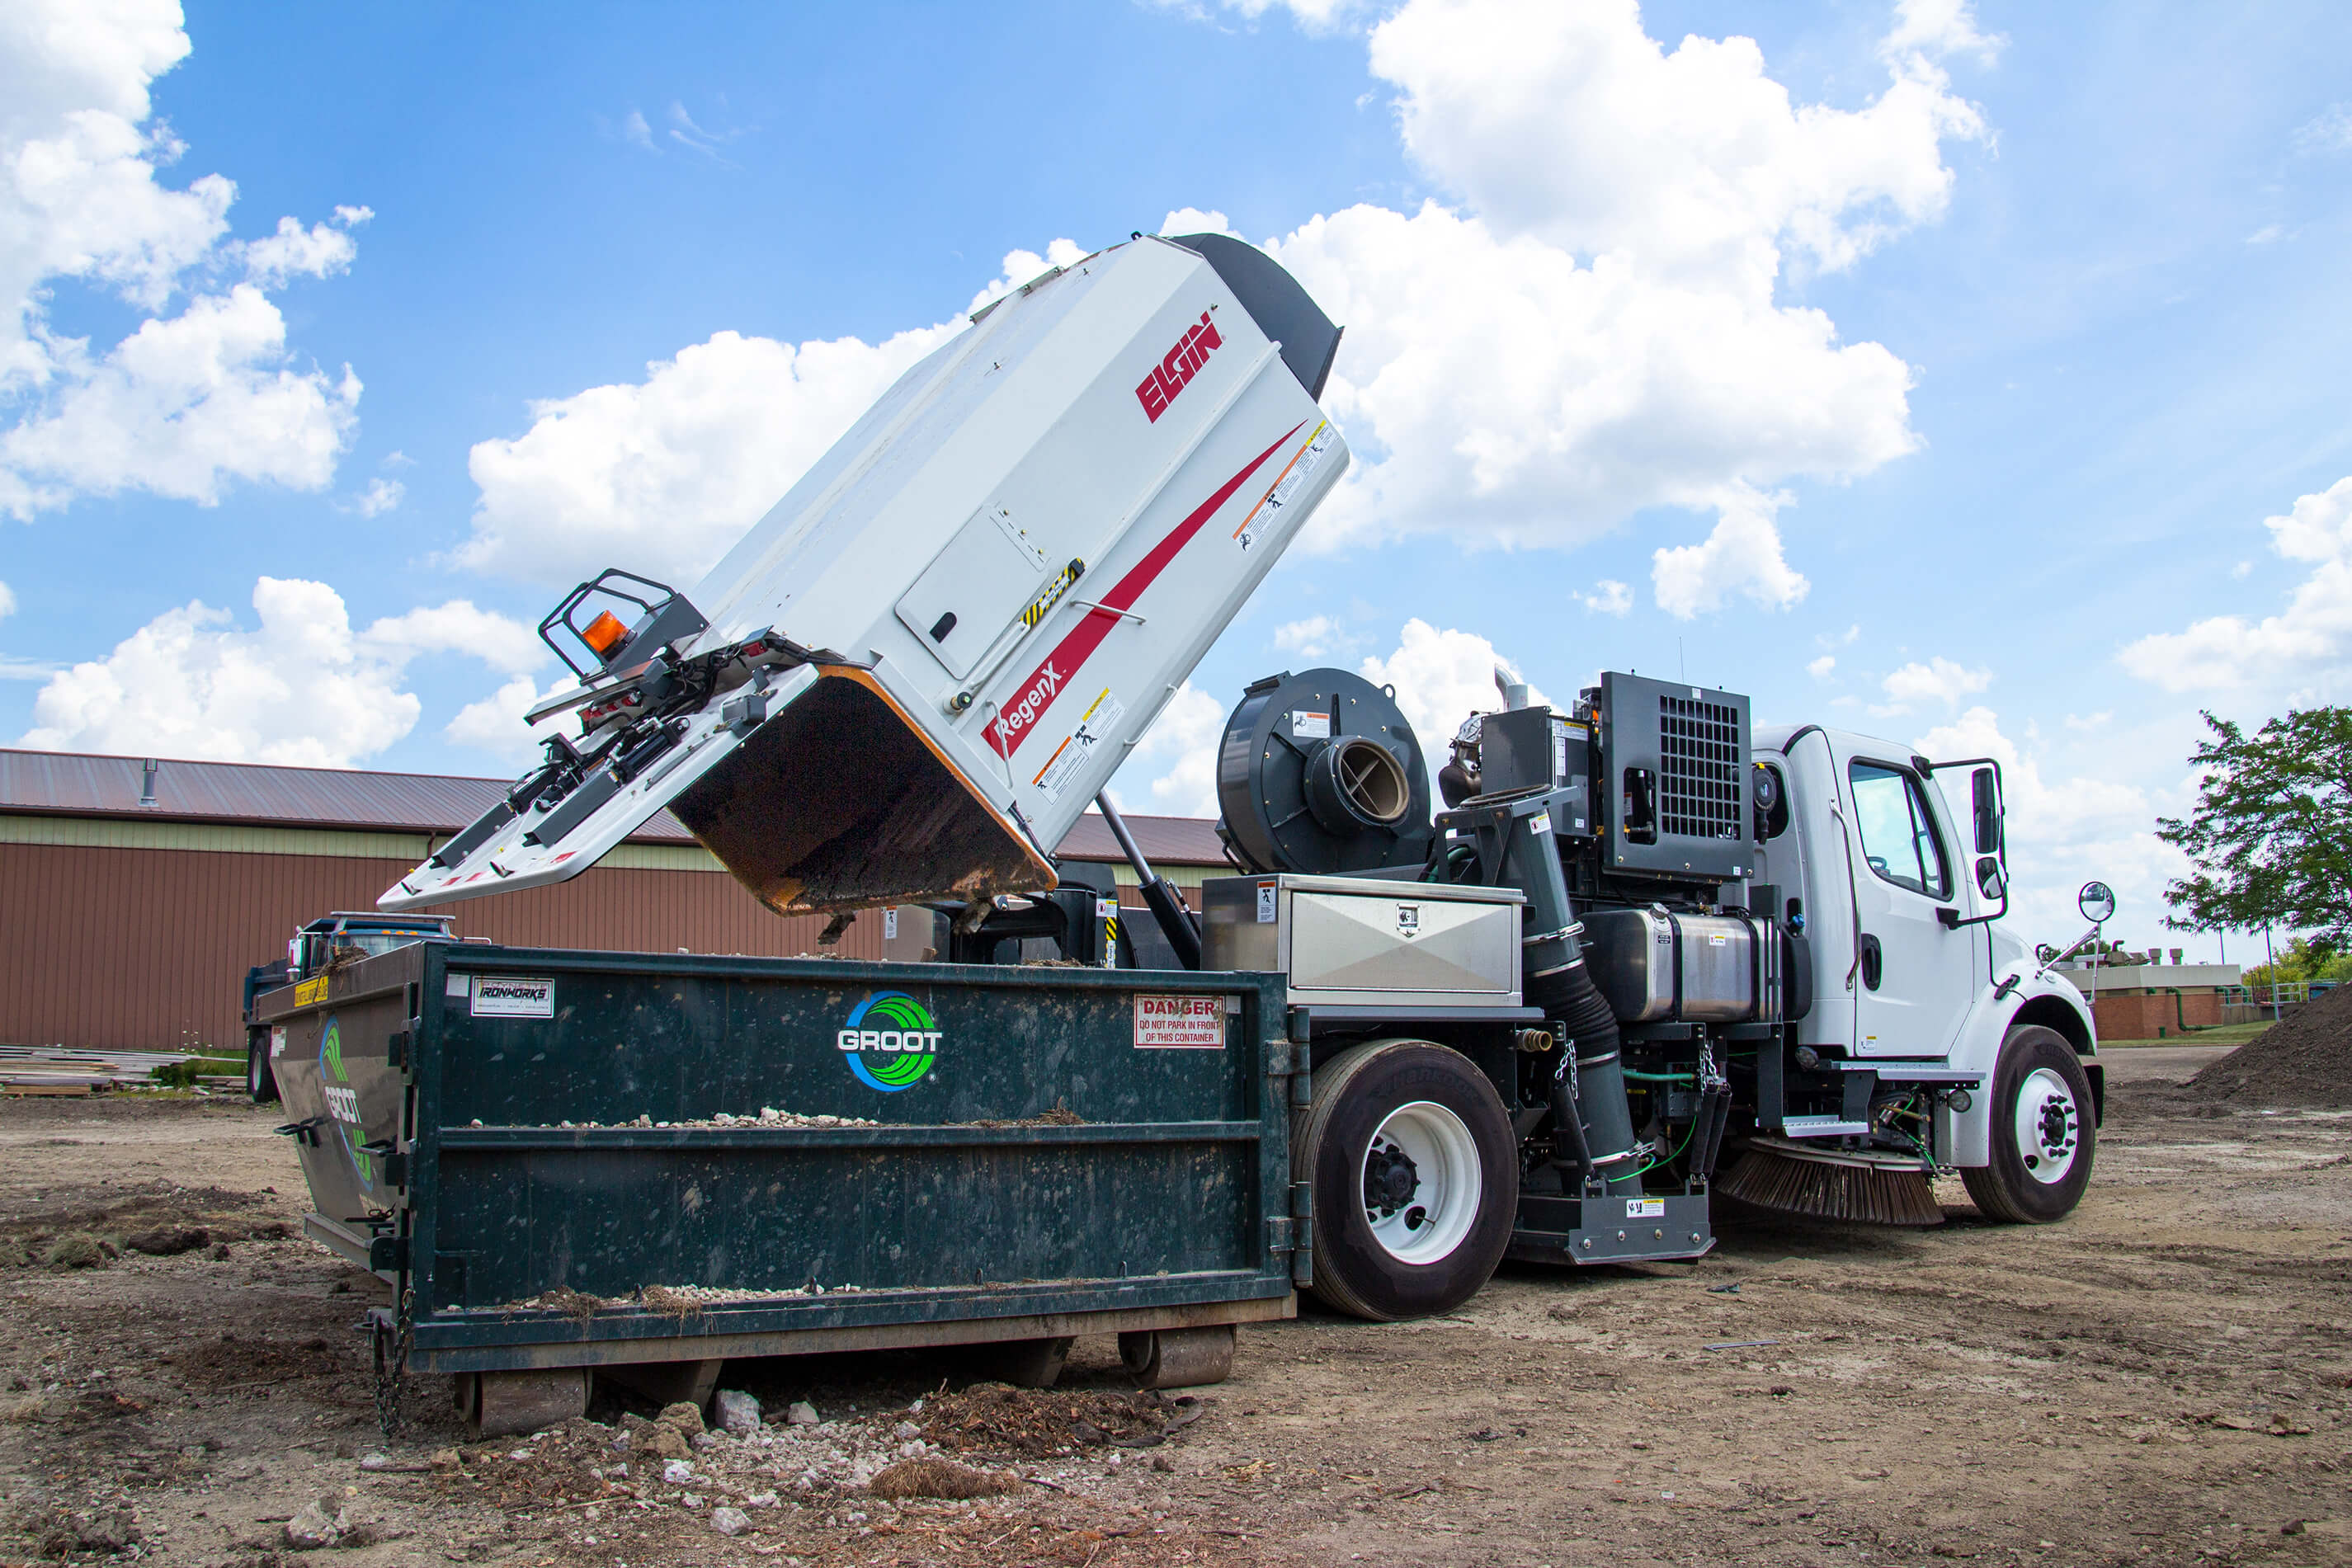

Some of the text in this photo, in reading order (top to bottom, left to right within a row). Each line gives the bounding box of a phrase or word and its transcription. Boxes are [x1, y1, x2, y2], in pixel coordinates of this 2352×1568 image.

[1134, 309, 1223, 425] ELGIN
[993, 660, 1063, 741] RegenX
[478, 987, 547, 1003] IRONWORKS
[1143, 1001, 1215, 1015] DANGER
[1139, 1020, 1219, 1030] DO NOT PARK IN FRONT
[837, 1029, 943, 1052] GROOT
[1146, 1033, 1214, 1042] OF THIS CONTAINER
[324, 1085, 362, 1123] GROOT
